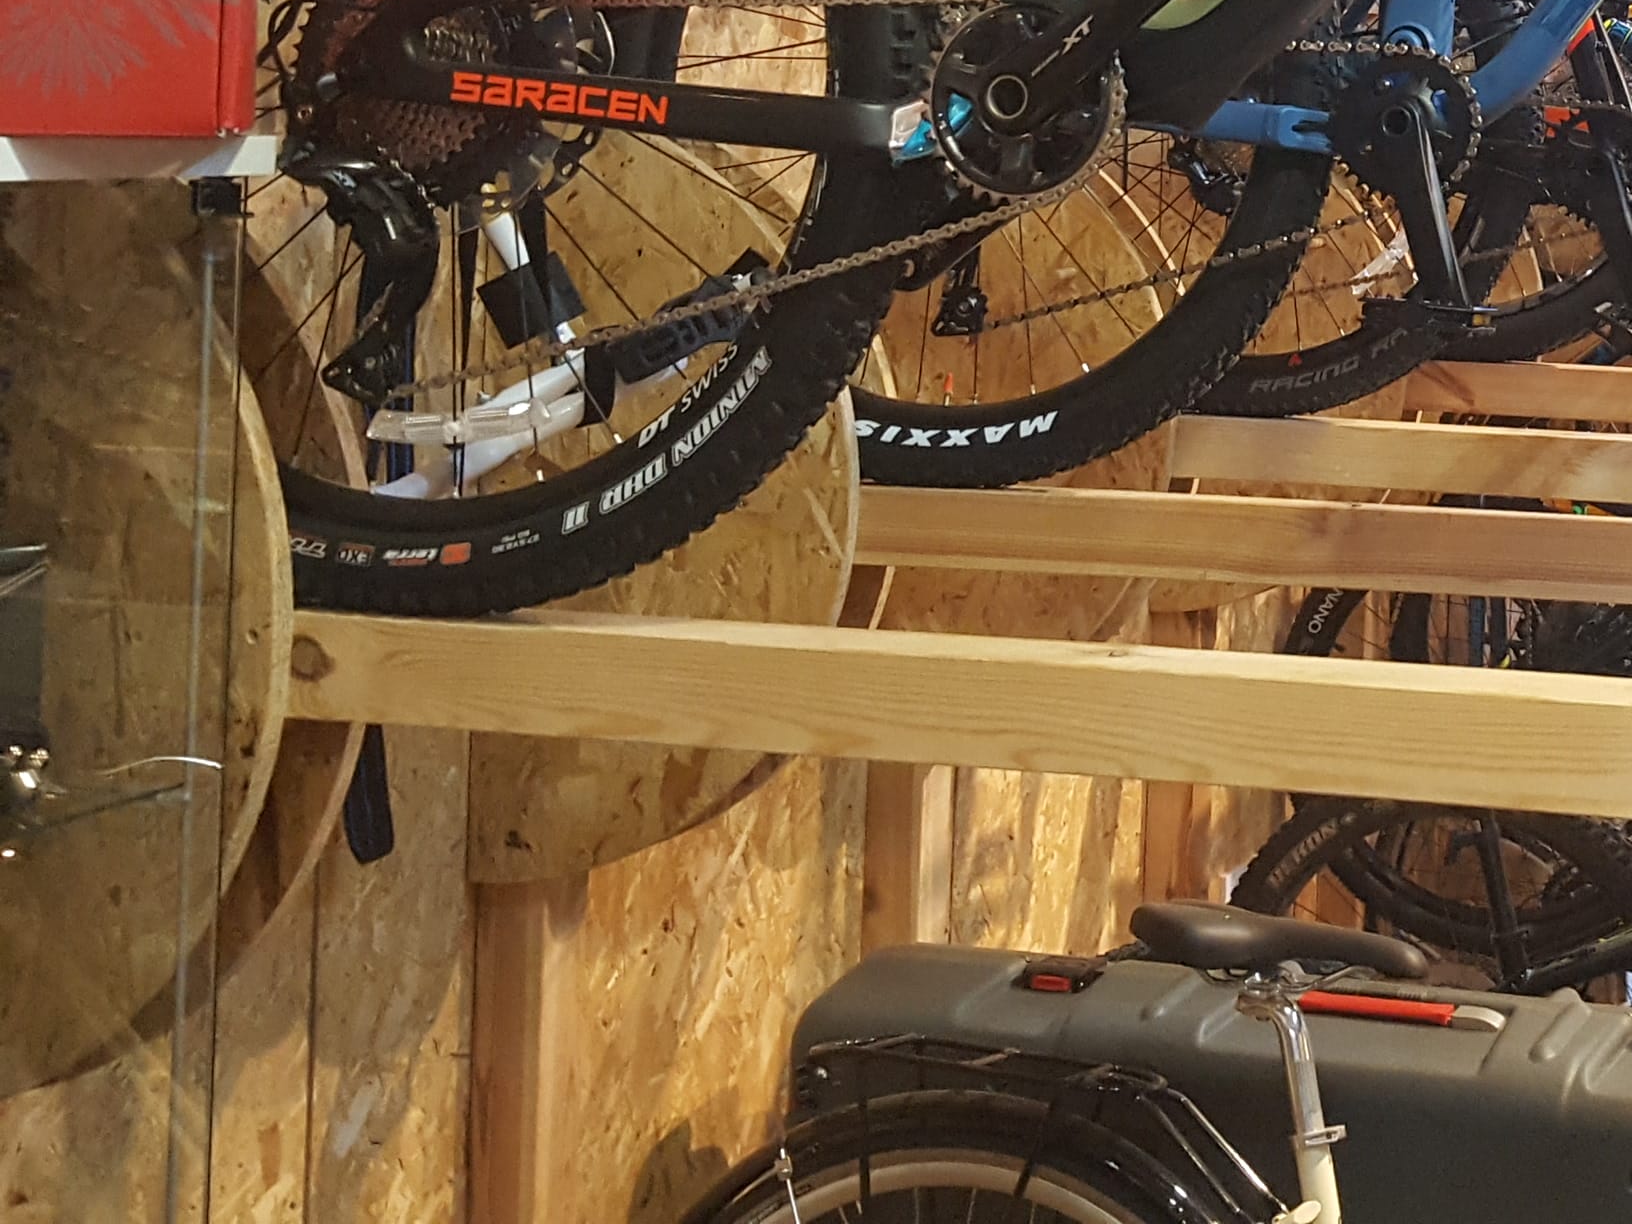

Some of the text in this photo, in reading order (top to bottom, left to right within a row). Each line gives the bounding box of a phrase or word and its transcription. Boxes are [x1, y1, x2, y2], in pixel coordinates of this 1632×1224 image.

[1062, 14, 1094, 55] XT
[451, 72, 667, 124] SARACEN
[638, 343, 738, 448] DT SWISS
[1249, 355, 1359, 393] RACING
[672, 346, 772, 467] MINION
[855, 410, 1060, 447] MAXXIS
[600, 452, 668, 516] DHR
[1308, 587, 1344, 634] NANO
